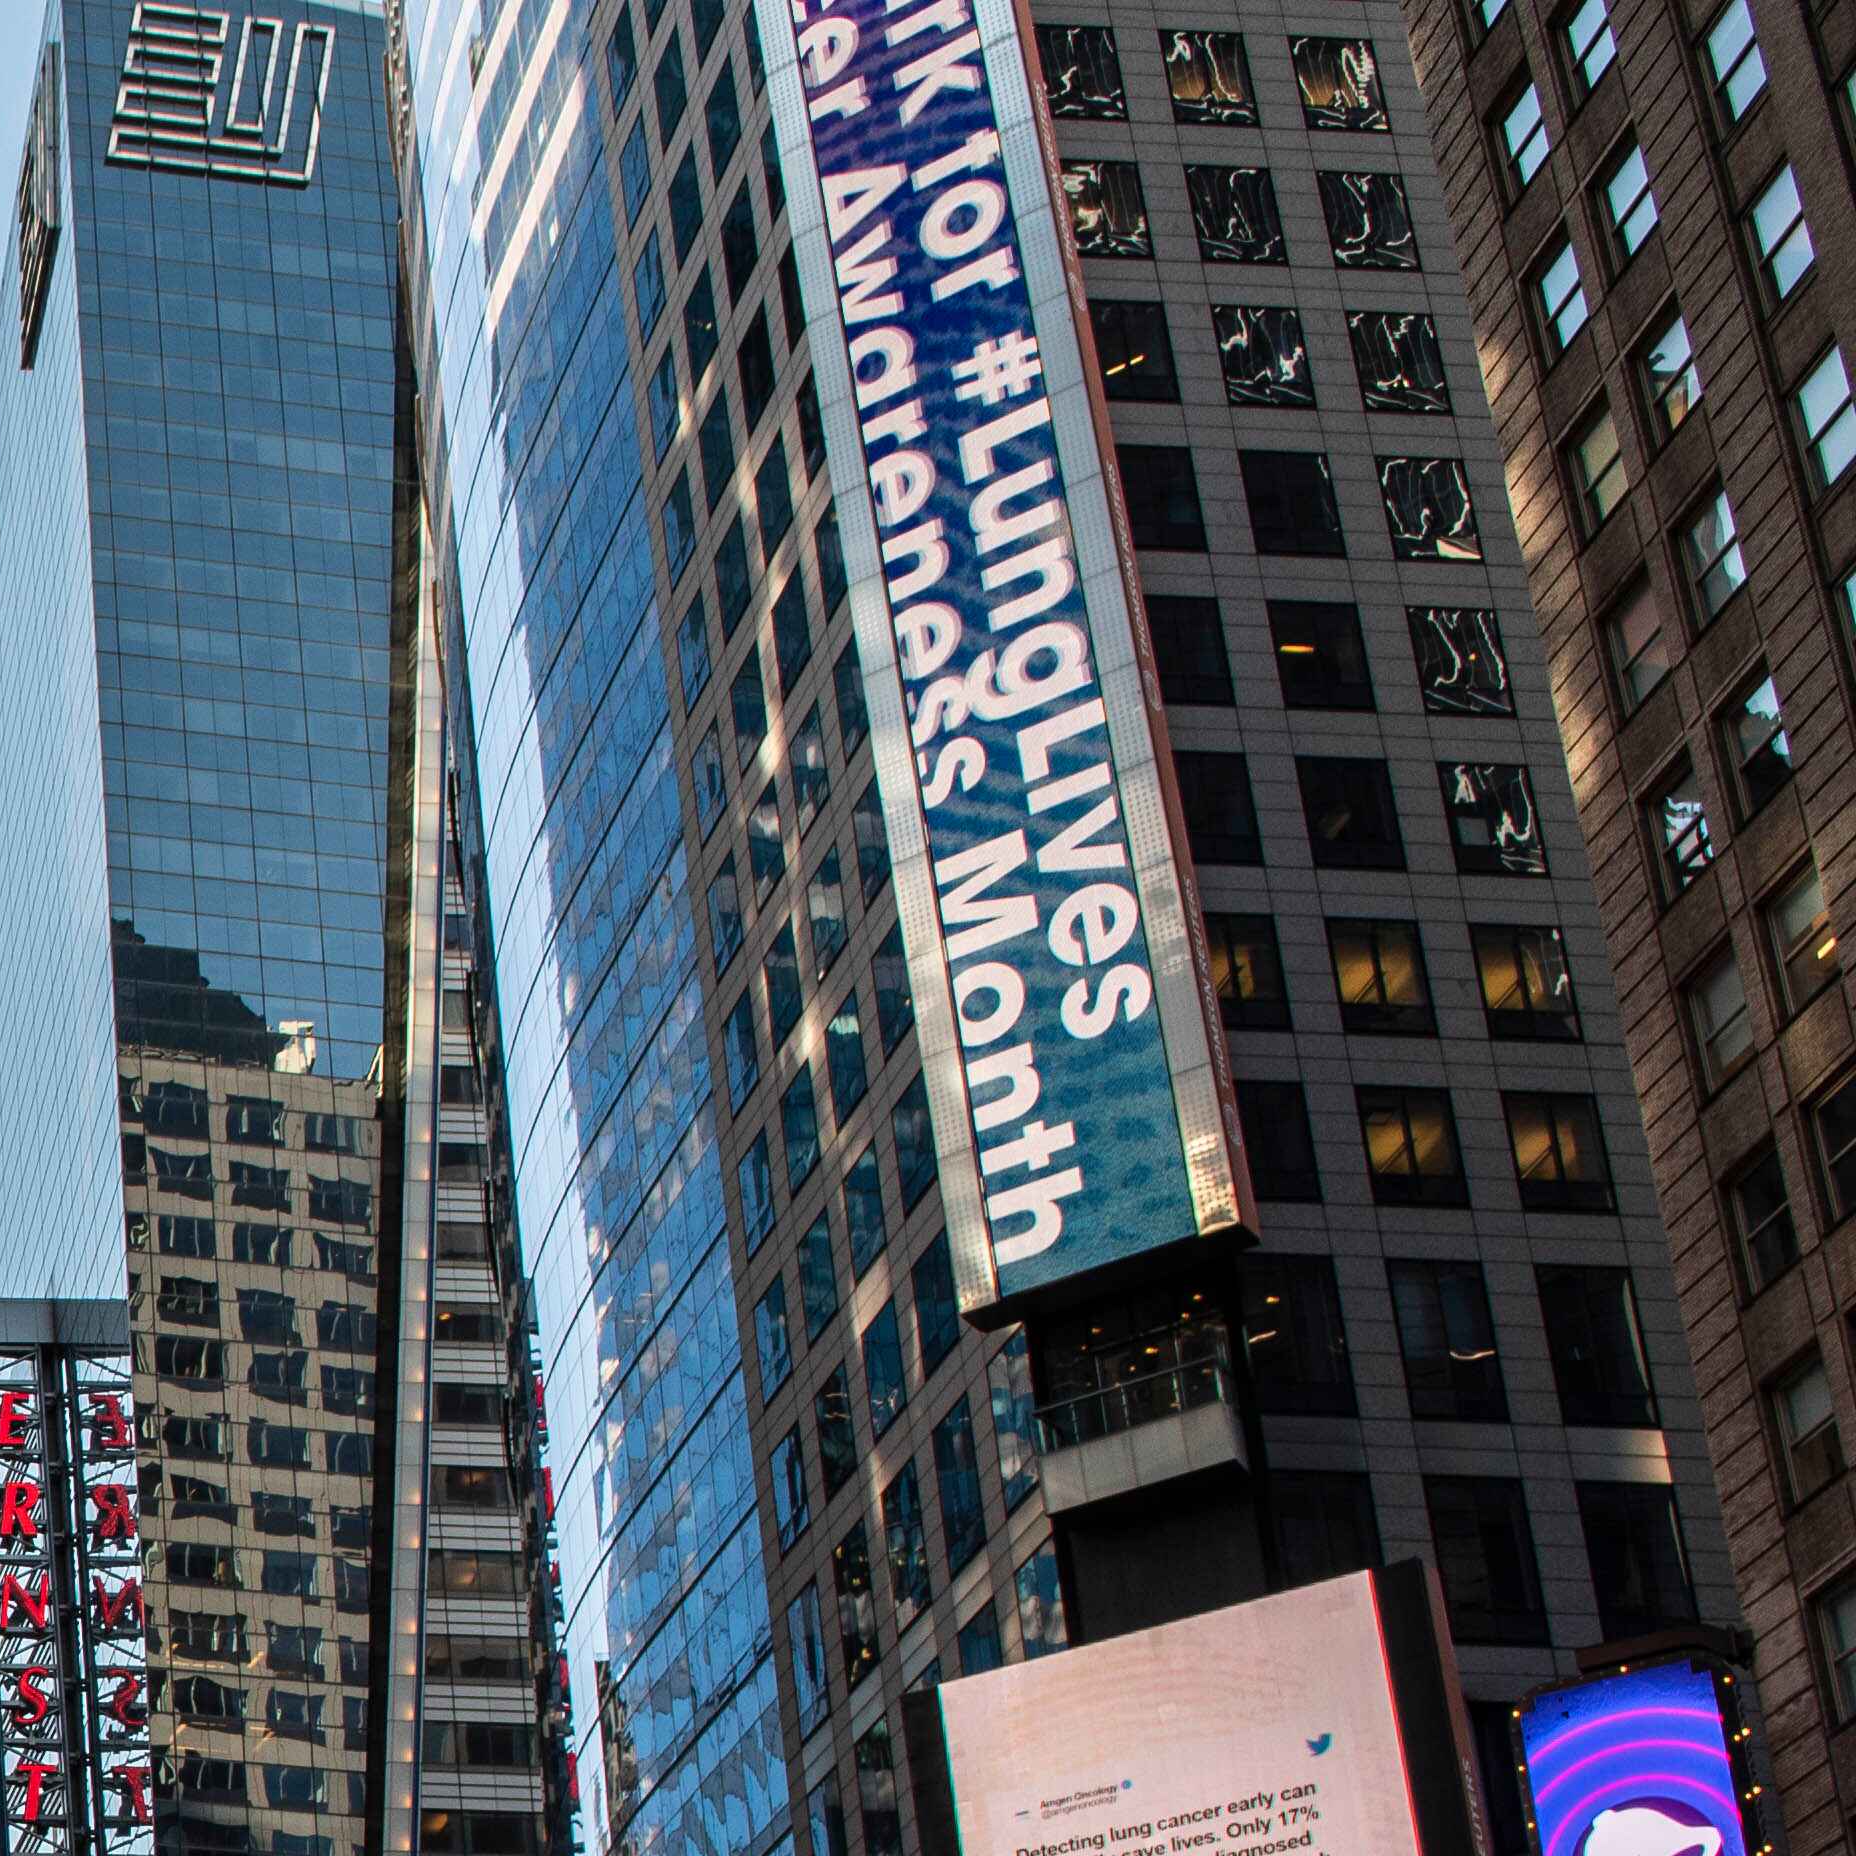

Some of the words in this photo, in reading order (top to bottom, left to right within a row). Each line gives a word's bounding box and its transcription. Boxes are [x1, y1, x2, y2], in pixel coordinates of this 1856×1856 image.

[794, 0, 872, 130] er
[910, 127, 1022, 306] for
[821, 161, 988, 808] Awareness
[953, 329, 1153, 1045] #LungLives
[933, 827, 1085, 1265] Month
[1109, 1819, 1153, 1844] lung
[1156, 1804, 1222, 1831] cancer
[1227, 1791, 1276, 1815] early
[1280, 1782, 1318, 1802] can
[1170, 1829, 1222, 1852] lives.
[1226, 1817, 1273, 1839] Only
[1278, 1804, 1321, 1827] 17%
